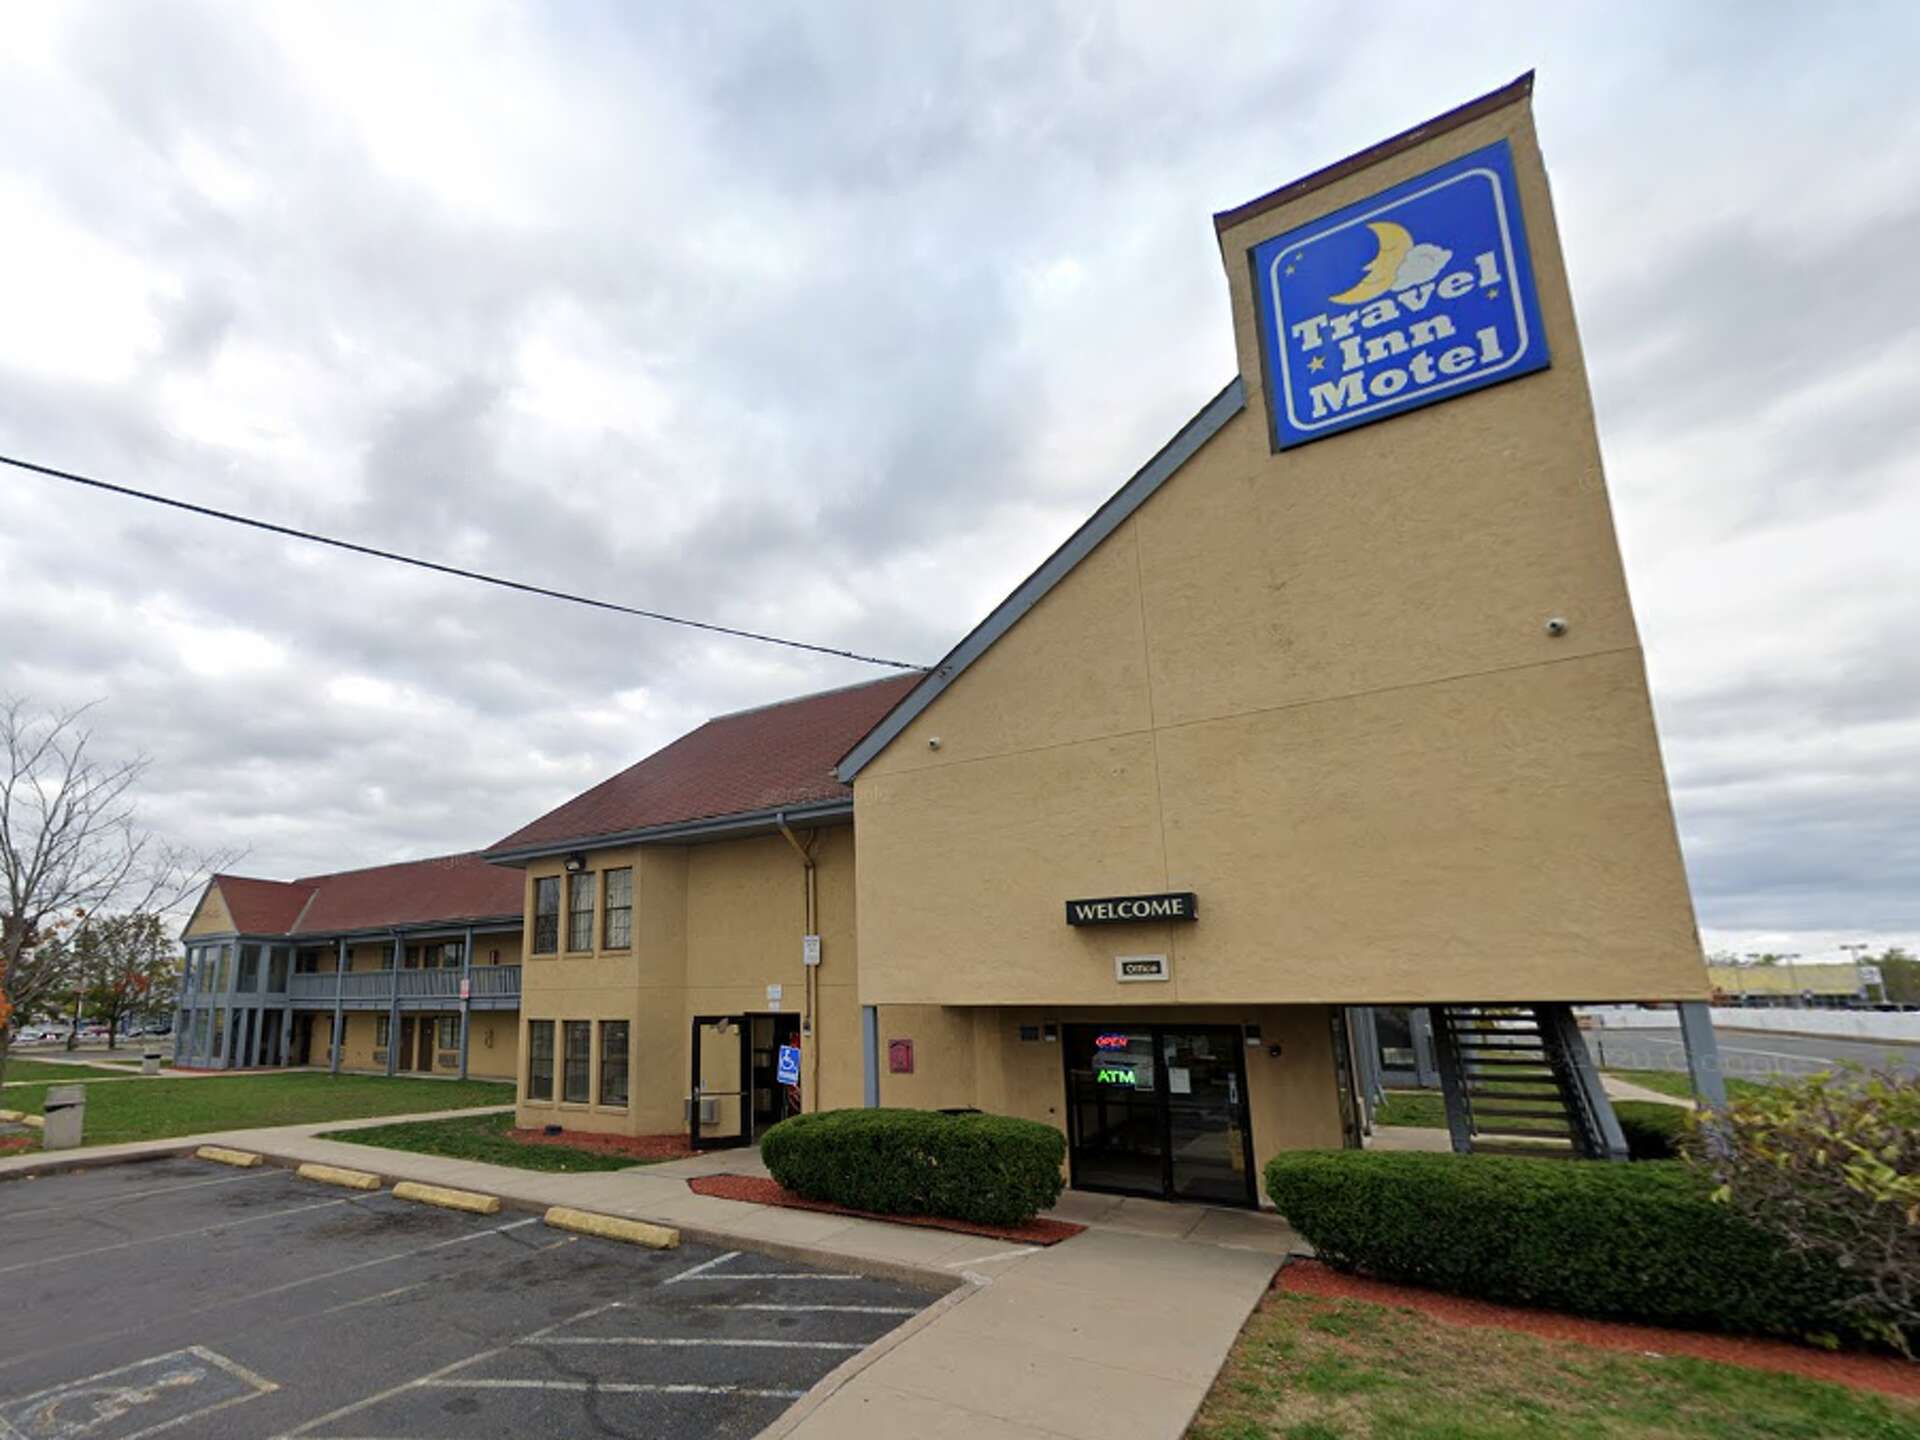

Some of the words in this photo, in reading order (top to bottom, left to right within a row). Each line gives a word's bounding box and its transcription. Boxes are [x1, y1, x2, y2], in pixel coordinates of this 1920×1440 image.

[1291, 250, 1502, 351] Travel
[1339, 313, 1456, 372] Inn
[1308, 326, 1503, 418] Motel
[1075, 898, 1185, 921] WELCOME
[1095, 1036, 1128, 1047] OPEN
[1097, 1069, 1136, 1084] ATM
